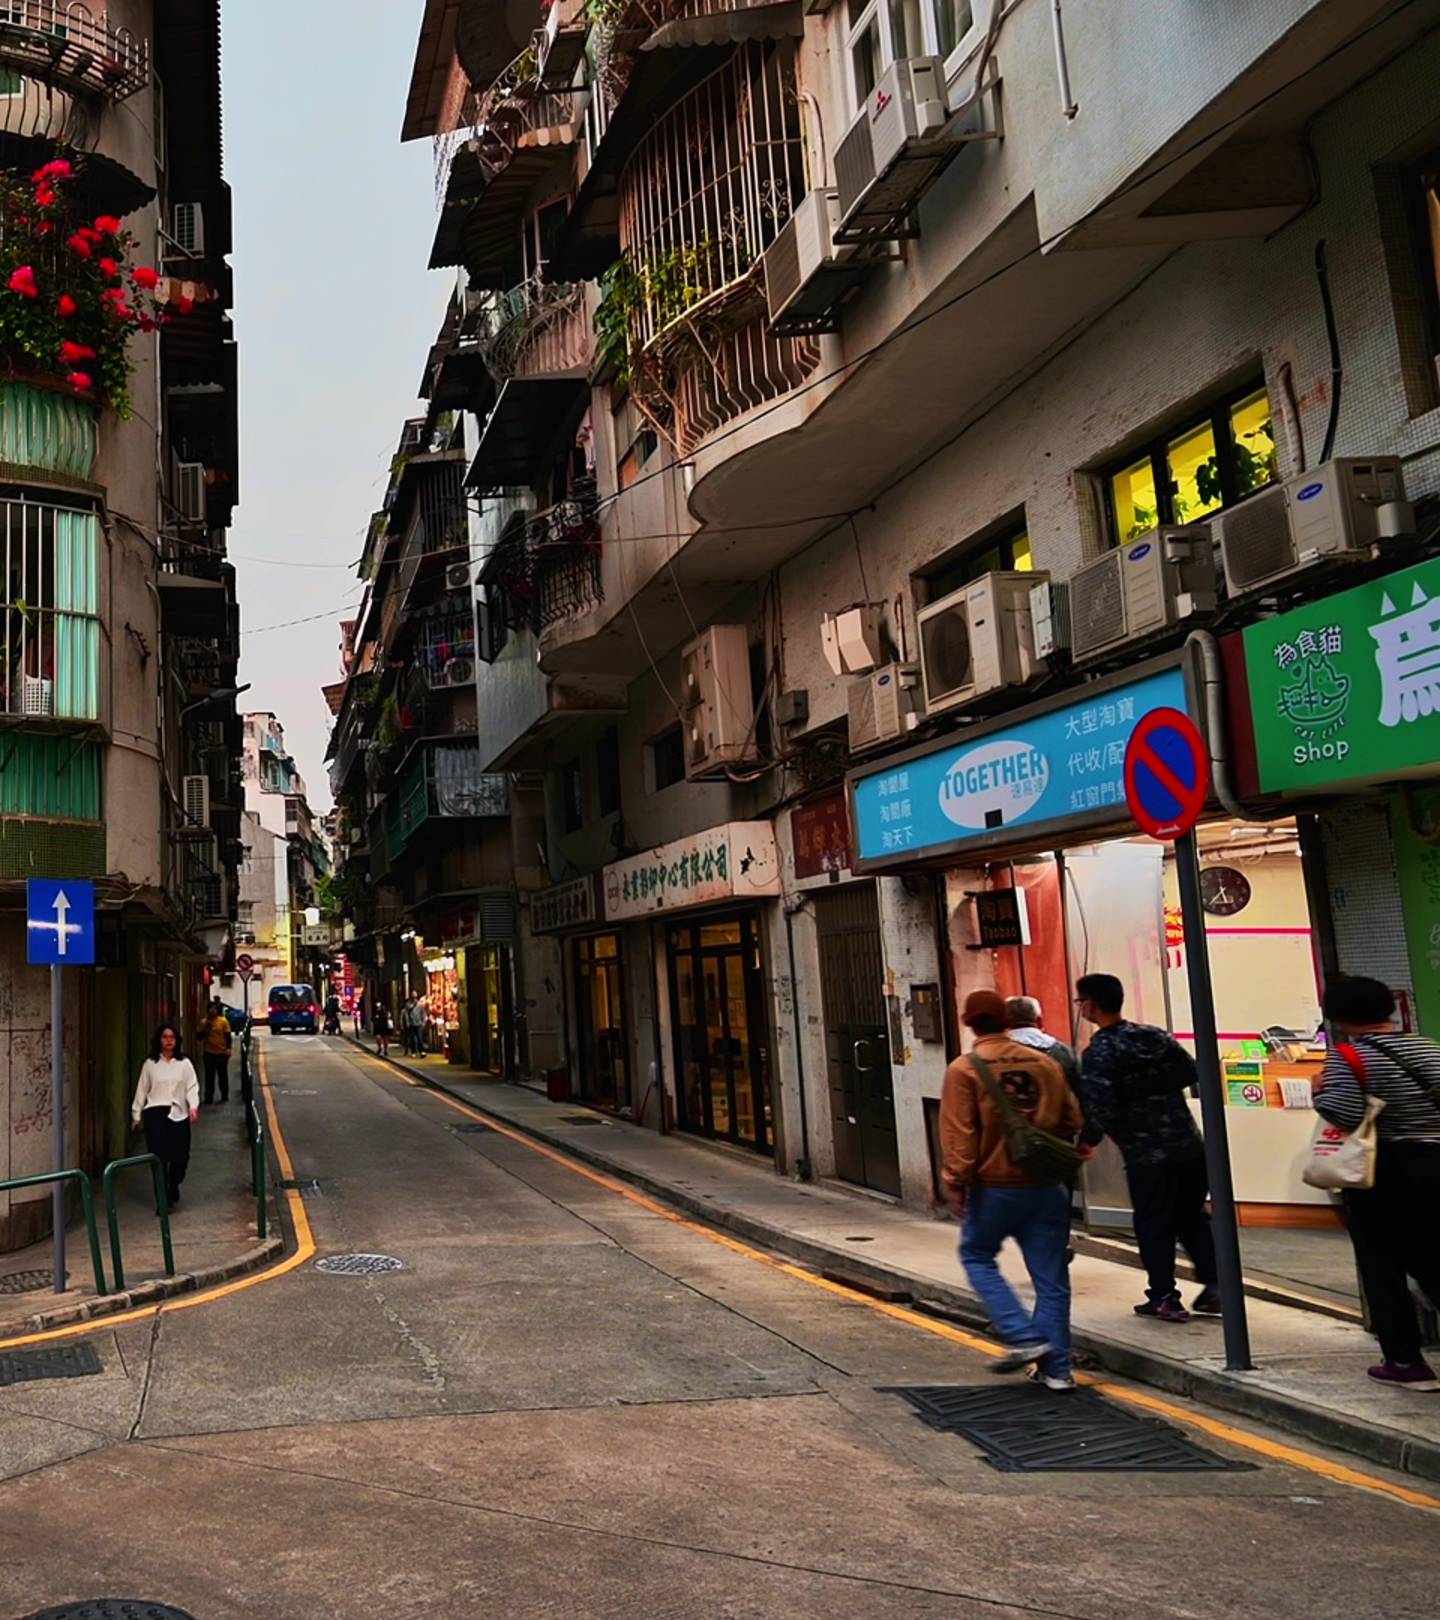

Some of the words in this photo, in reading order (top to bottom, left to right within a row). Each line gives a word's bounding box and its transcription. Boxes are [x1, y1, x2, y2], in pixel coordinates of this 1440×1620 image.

[1273, 625, 1342, 669] 為食貓
[1065, 697, 1135, 740] 大型淘寶
[1067, 737, 1130, 777] 代收/配
[1293, 740, 1349, 764] Shop
[944, 750, 1044, 800] TOGETHER
